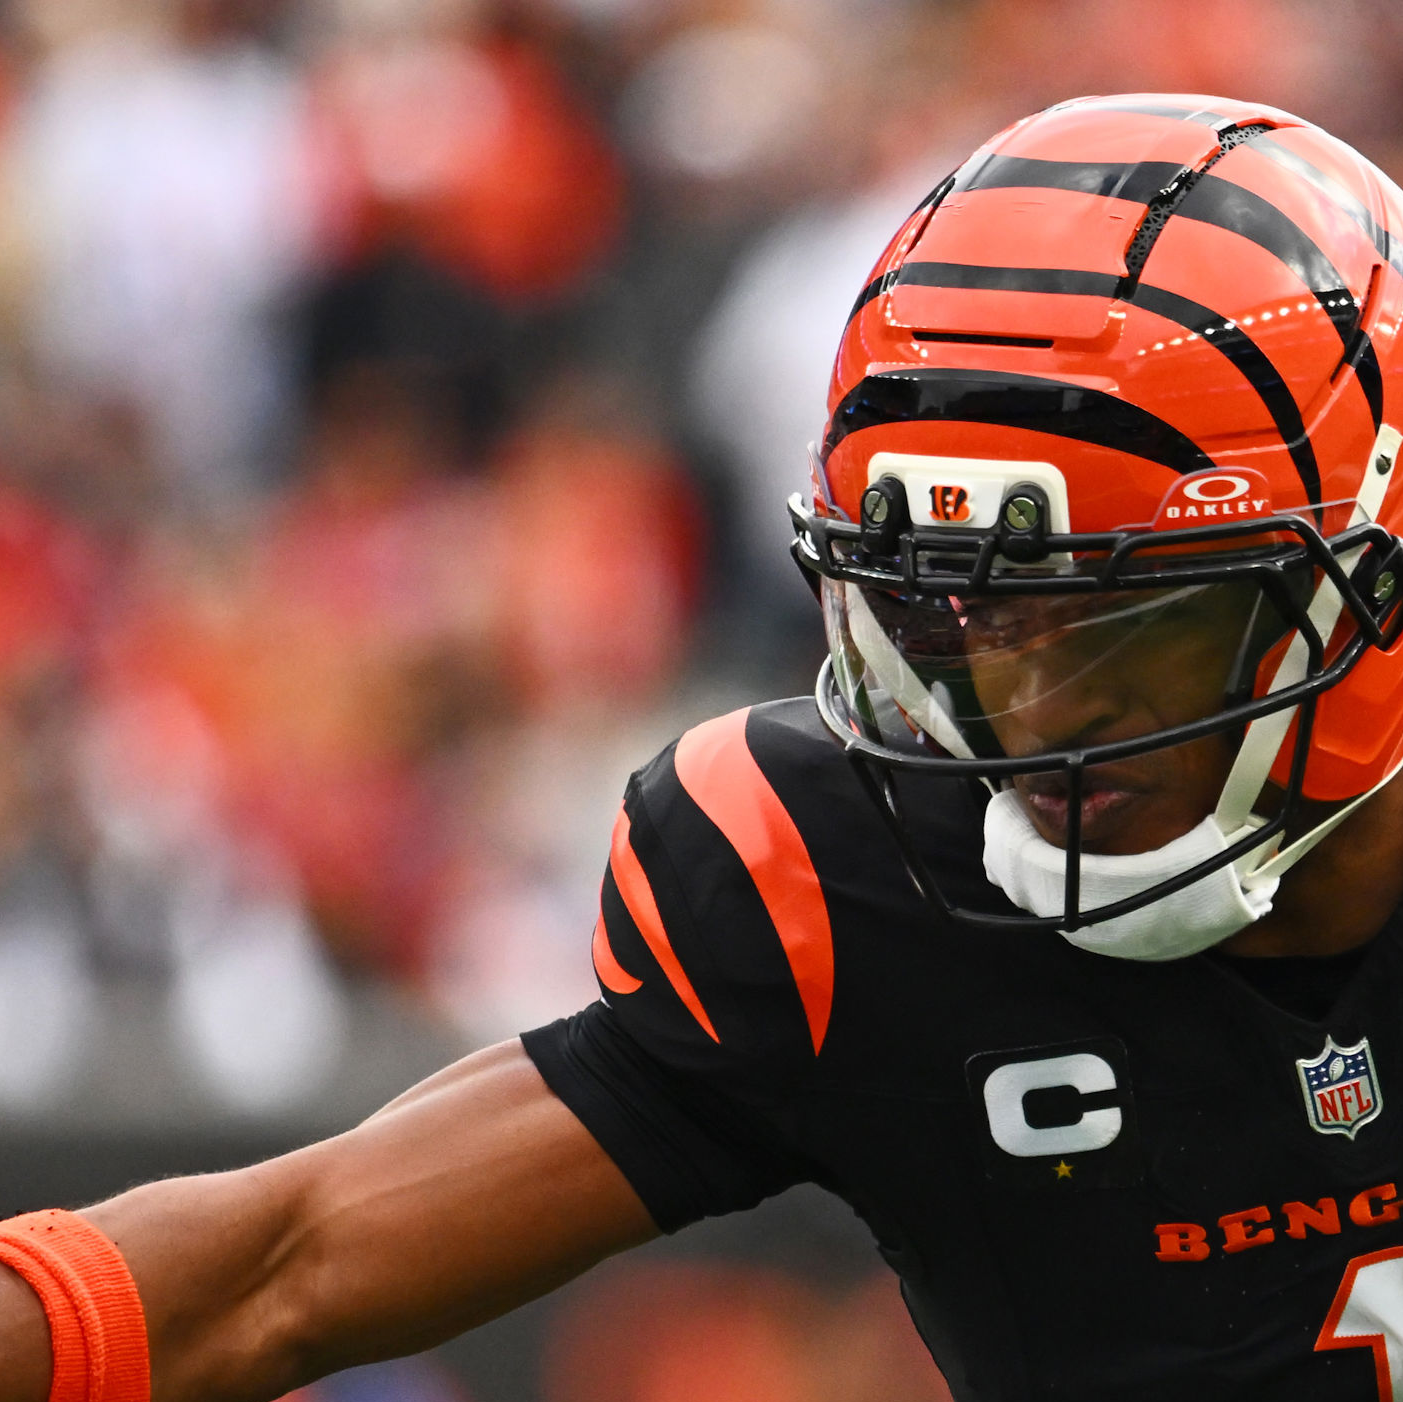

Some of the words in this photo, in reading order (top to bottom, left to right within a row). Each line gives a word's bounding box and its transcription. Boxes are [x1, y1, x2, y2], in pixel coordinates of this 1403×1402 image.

[1166, 499, 1265, 519] OAKLEY
[983, 1052, 1124, 1158] C
[1316, 1080, 1373, 1123] NFL
